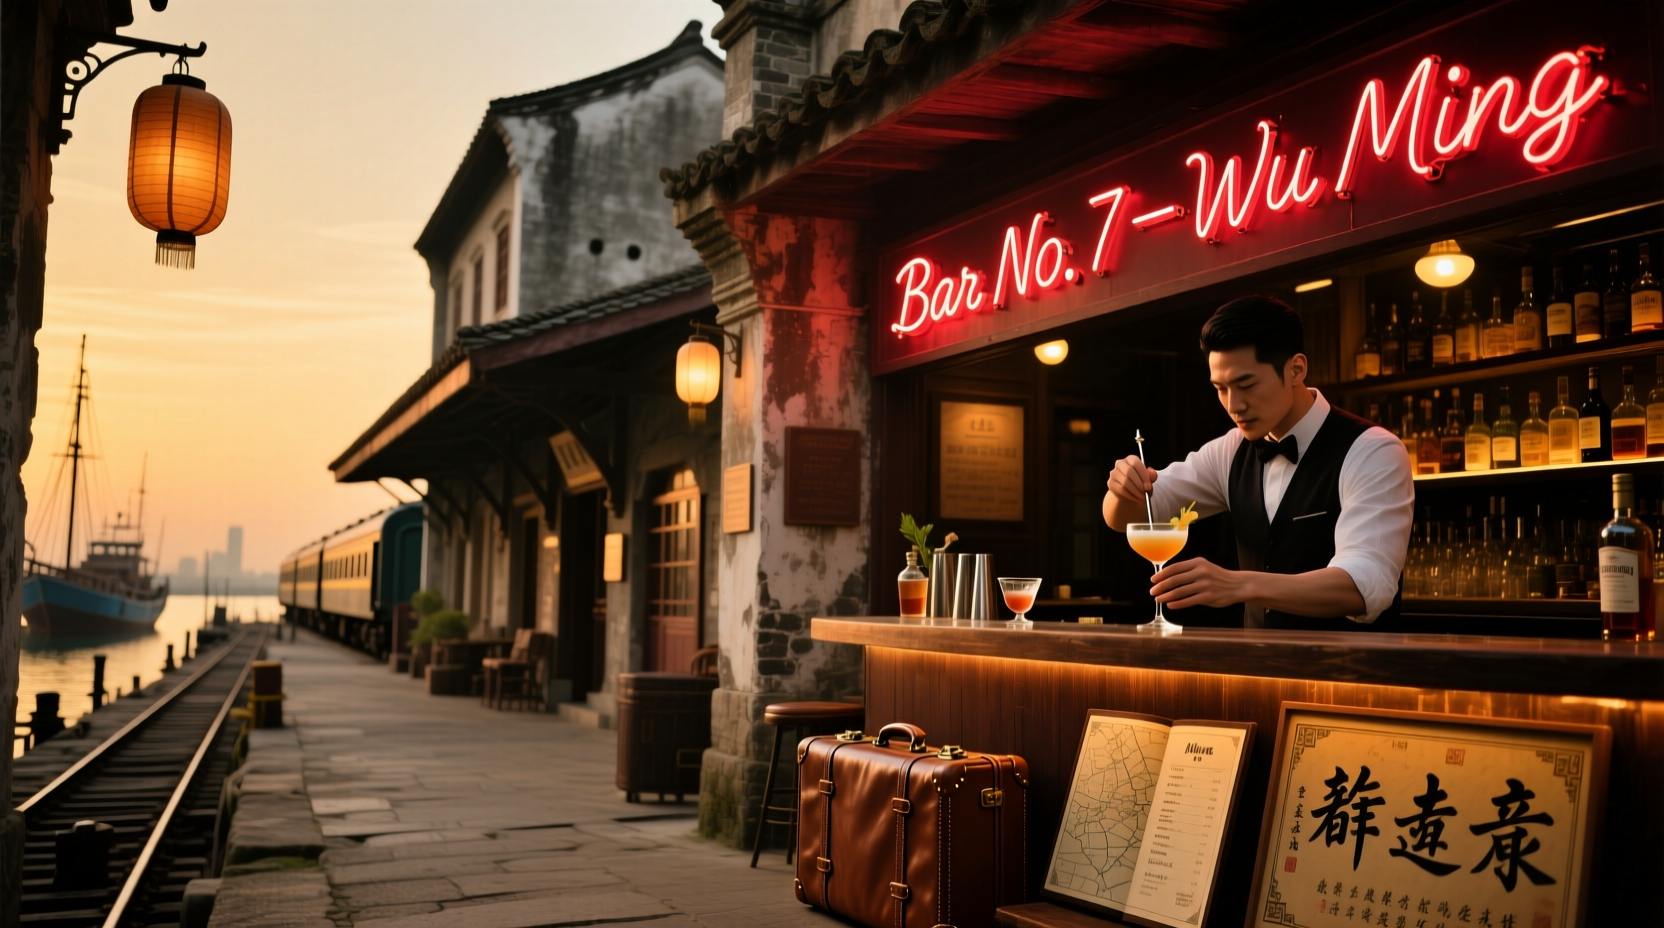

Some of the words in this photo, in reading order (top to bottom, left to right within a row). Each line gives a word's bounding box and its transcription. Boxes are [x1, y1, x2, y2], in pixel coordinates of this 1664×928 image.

[891, 257, 984, 333] Bar
[993, 212, 1076, 305] No.
[1089, 186, 1126, 272] 7
[1185, 120, 1320, 238] Wu
[1334, 51, 1605, 193] Ming
